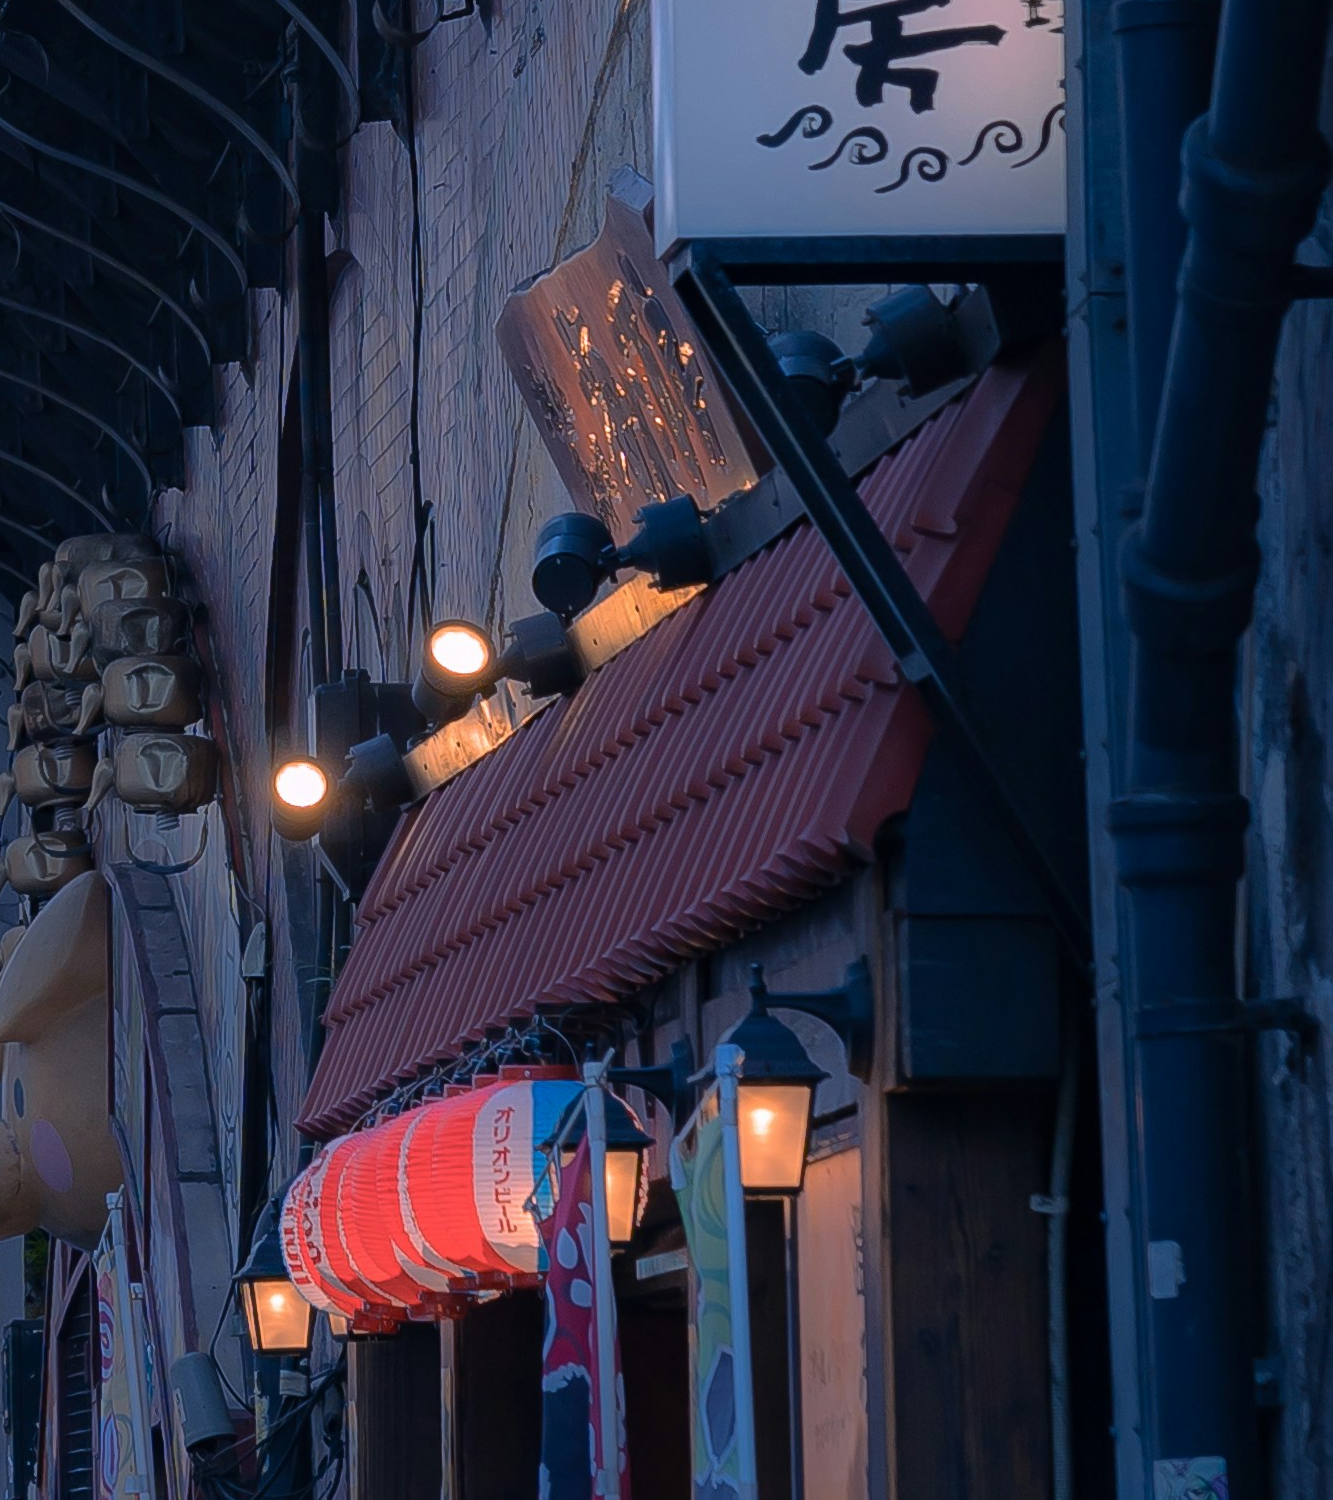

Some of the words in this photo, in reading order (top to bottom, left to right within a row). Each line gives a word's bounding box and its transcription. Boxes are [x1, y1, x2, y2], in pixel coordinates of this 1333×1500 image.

[491, 1106, 517, 1235] オリオンビール
